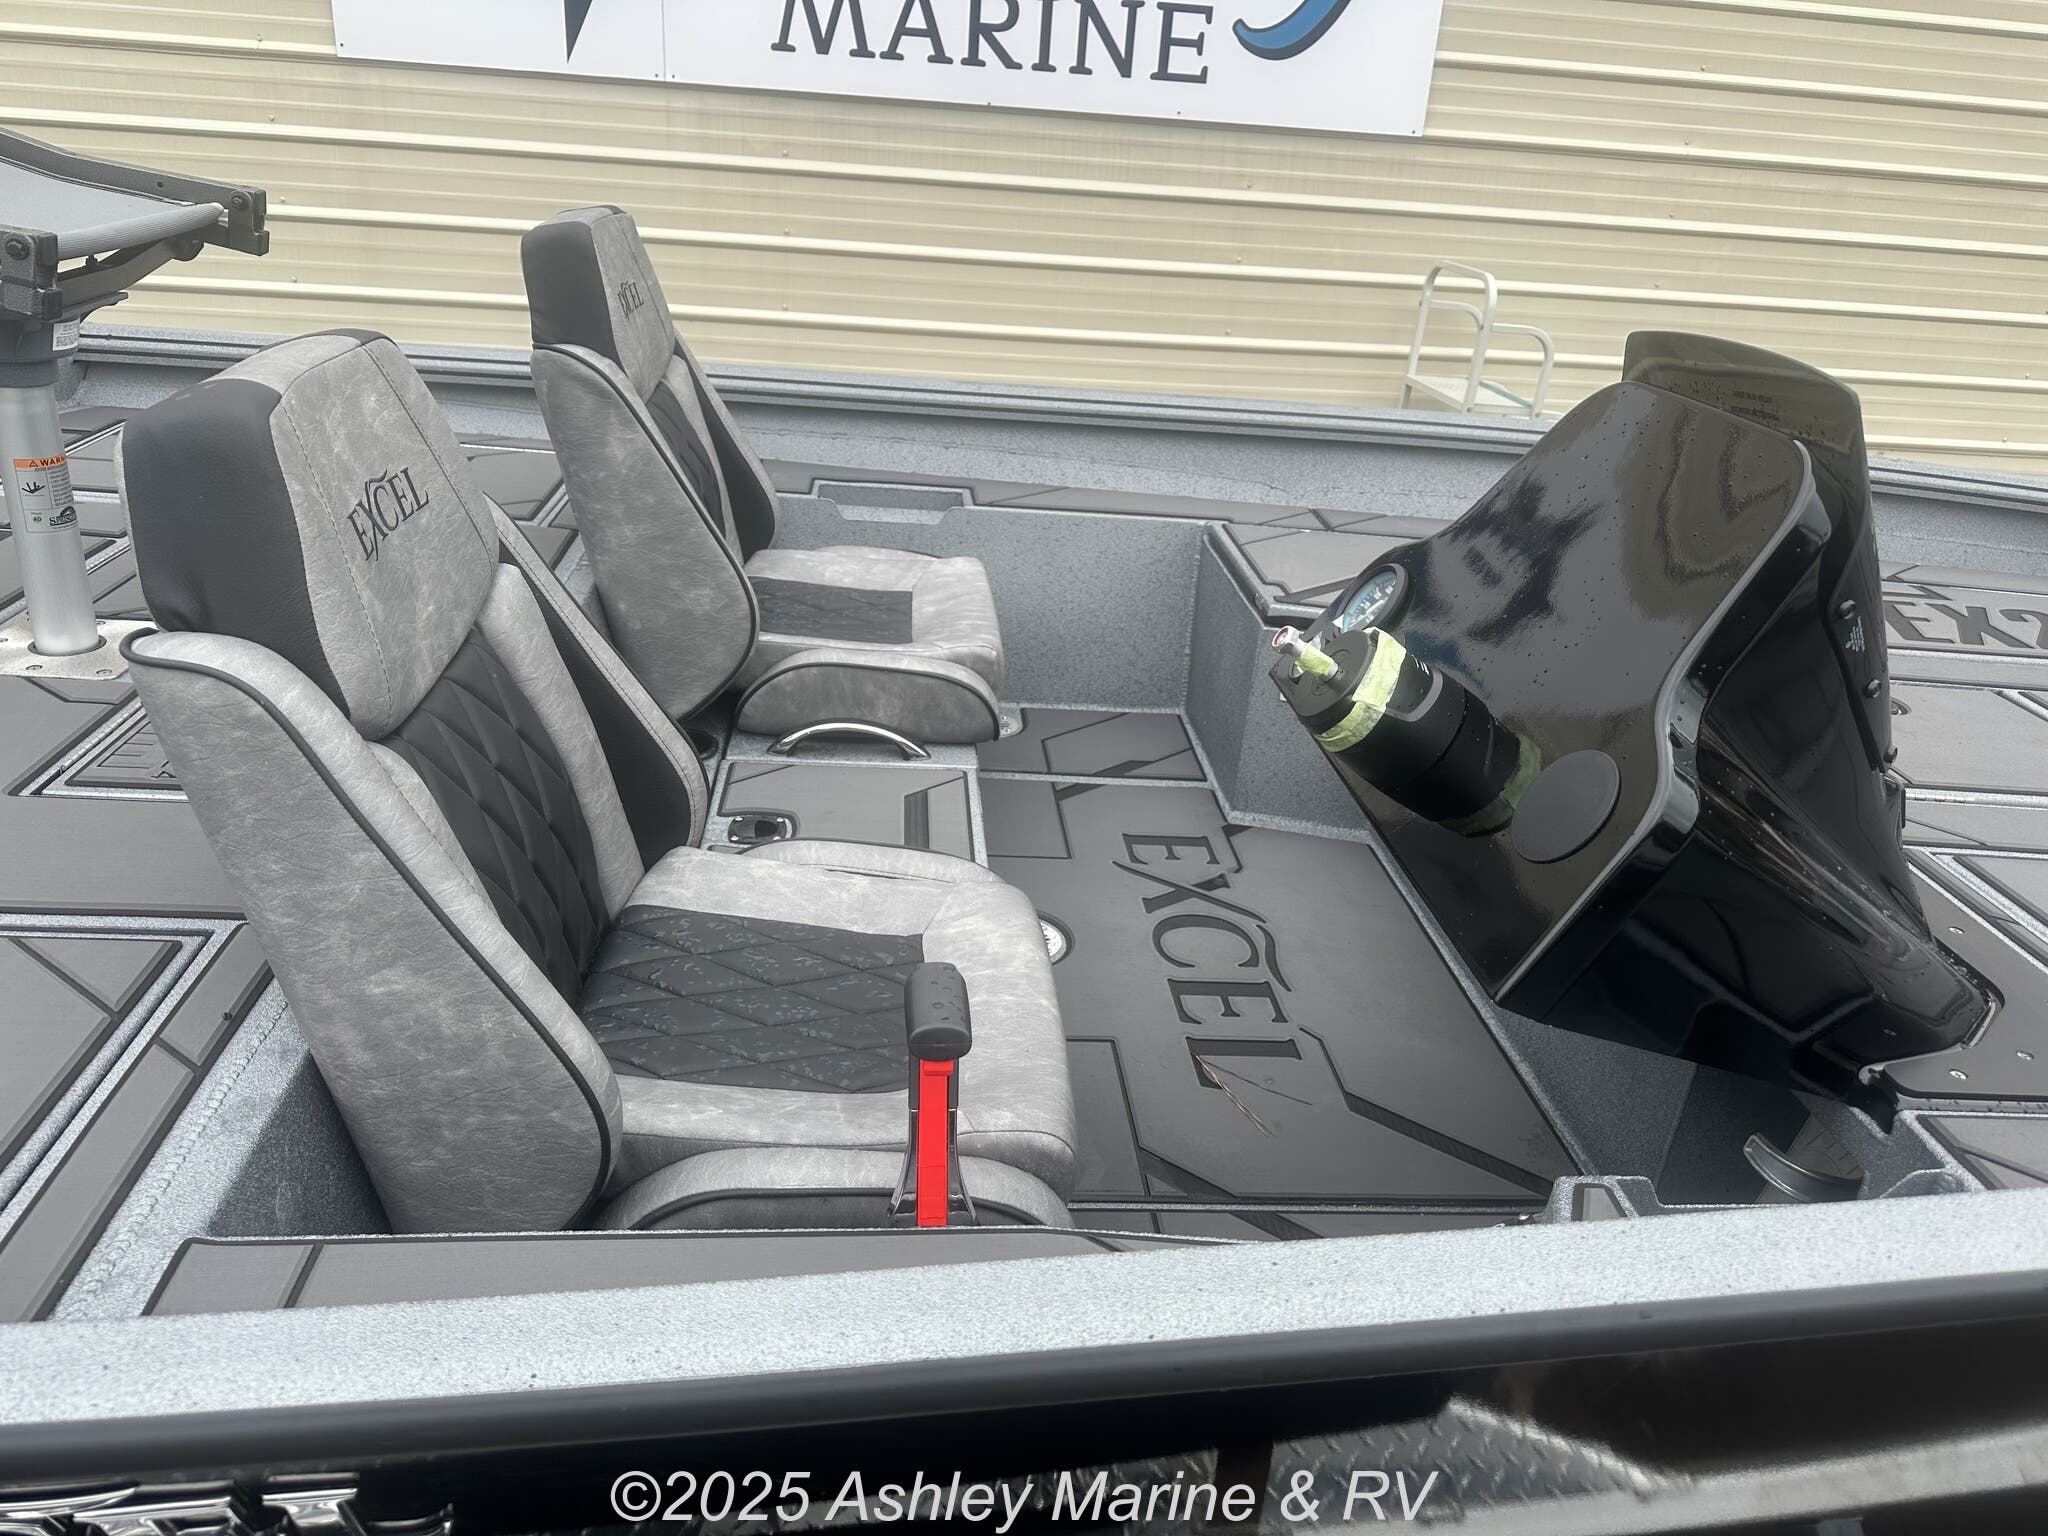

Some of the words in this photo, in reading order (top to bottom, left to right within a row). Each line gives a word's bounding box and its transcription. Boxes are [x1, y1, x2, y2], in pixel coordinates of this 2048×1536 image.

[771, 0, 1214, 84] MARINE
[617, 282, 645, 320] EXCEL
[347, 467, 430, 561] EXCEL
[1112, 833, 1302, 1090] EXCEL
